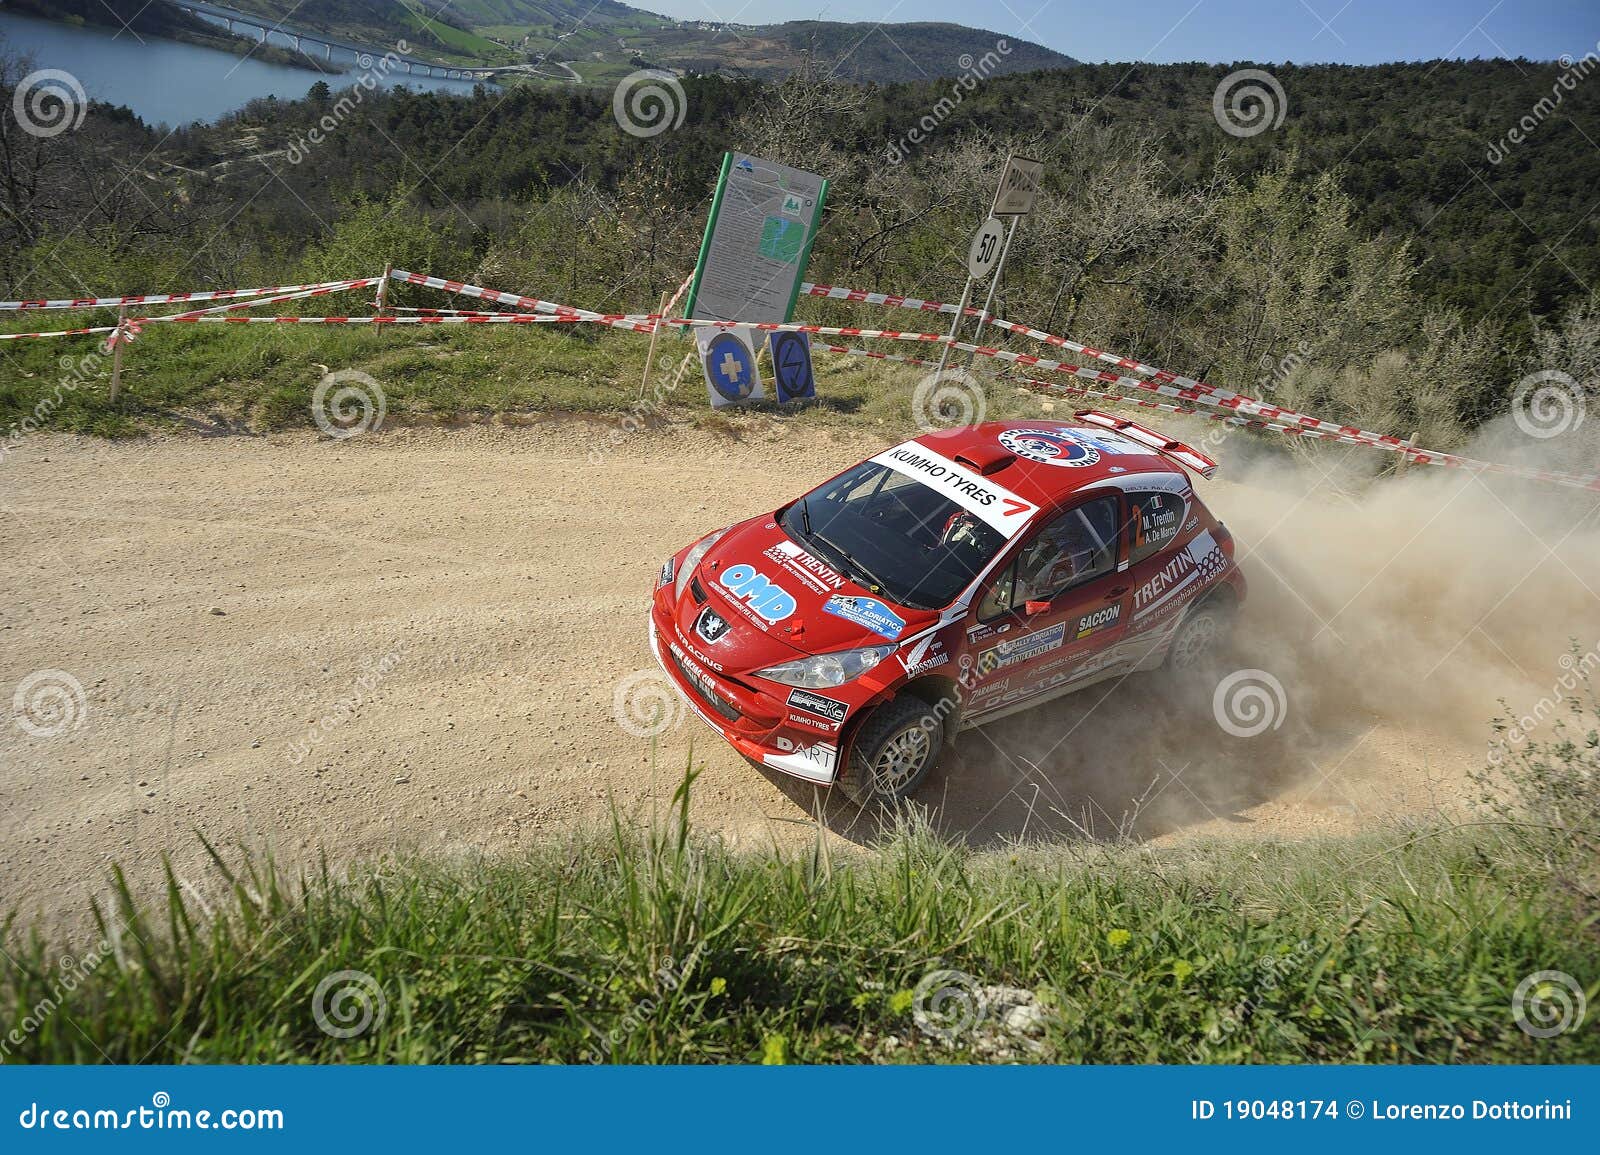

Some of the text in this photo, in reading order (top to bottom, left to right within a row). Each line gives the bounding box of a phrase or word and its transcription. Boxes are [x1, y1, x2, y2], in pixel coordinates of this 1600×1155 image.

[976, 233, 997, 264] 50
[1001, 438, 1047, 463] CLUB
[889, 449, 997, 506] KUMHO TYRES
[1132, 504, 1145, 548] 2
[1143, 515, 1152, 531] M.
[1152, 509, 1176, 527] Trentin
[1145, 525, 1177, 545] A. De Marco
[796, 551, 846, 589] TRENTIN
[1133, 548, 1195, 609] TRENTIN
[1204, 558, 1228, 585] ASFALTI
[865, 601, 876, 610] 2
[1079, 605, 1121, 632] SACCON
[863, 609, 903, 632] ADRIATICO
[1031, 626, 1063, 642] ADRIATICO
[790, 713, 830, 731] KUMHO TYRES
[776, 736, 835, 768] DART
